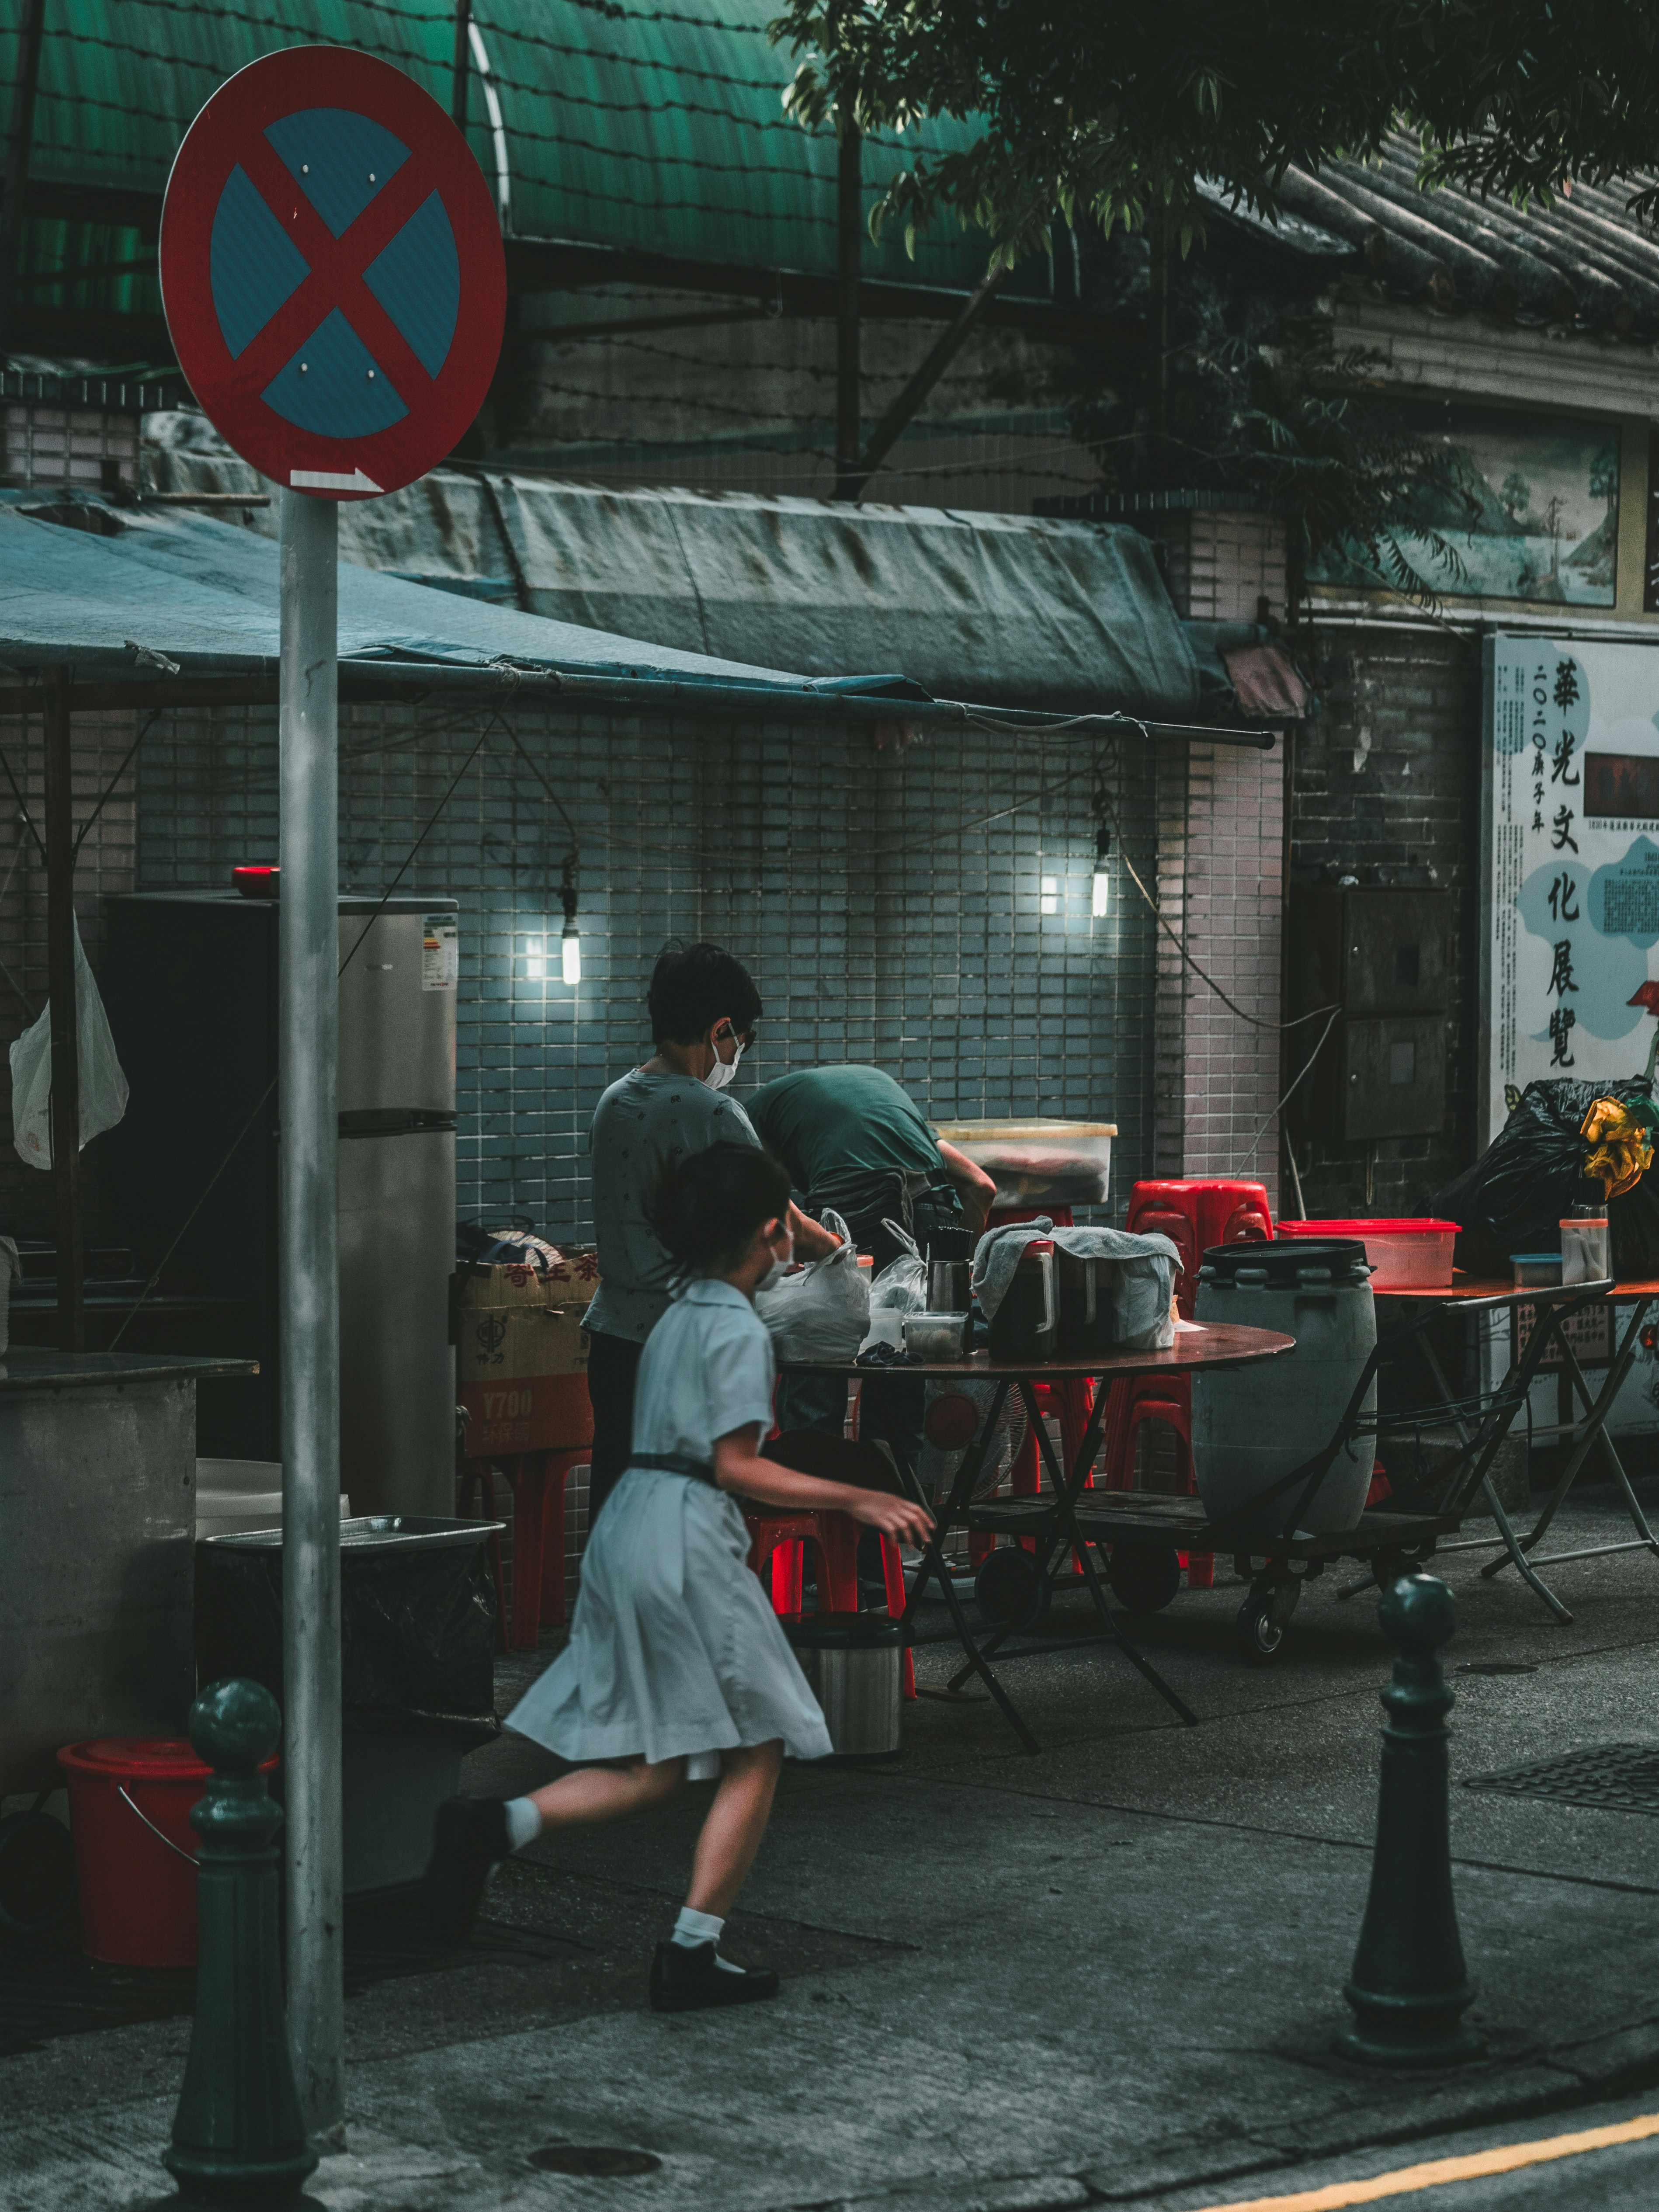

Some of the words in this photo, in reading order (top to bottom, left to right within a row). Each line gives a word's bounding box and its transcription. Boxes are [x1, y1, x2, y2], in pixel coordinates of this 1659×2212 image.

[1547, 658, 1580, 1068] 華光文化展覽
[483, 1389, 532, 1420] Y700
